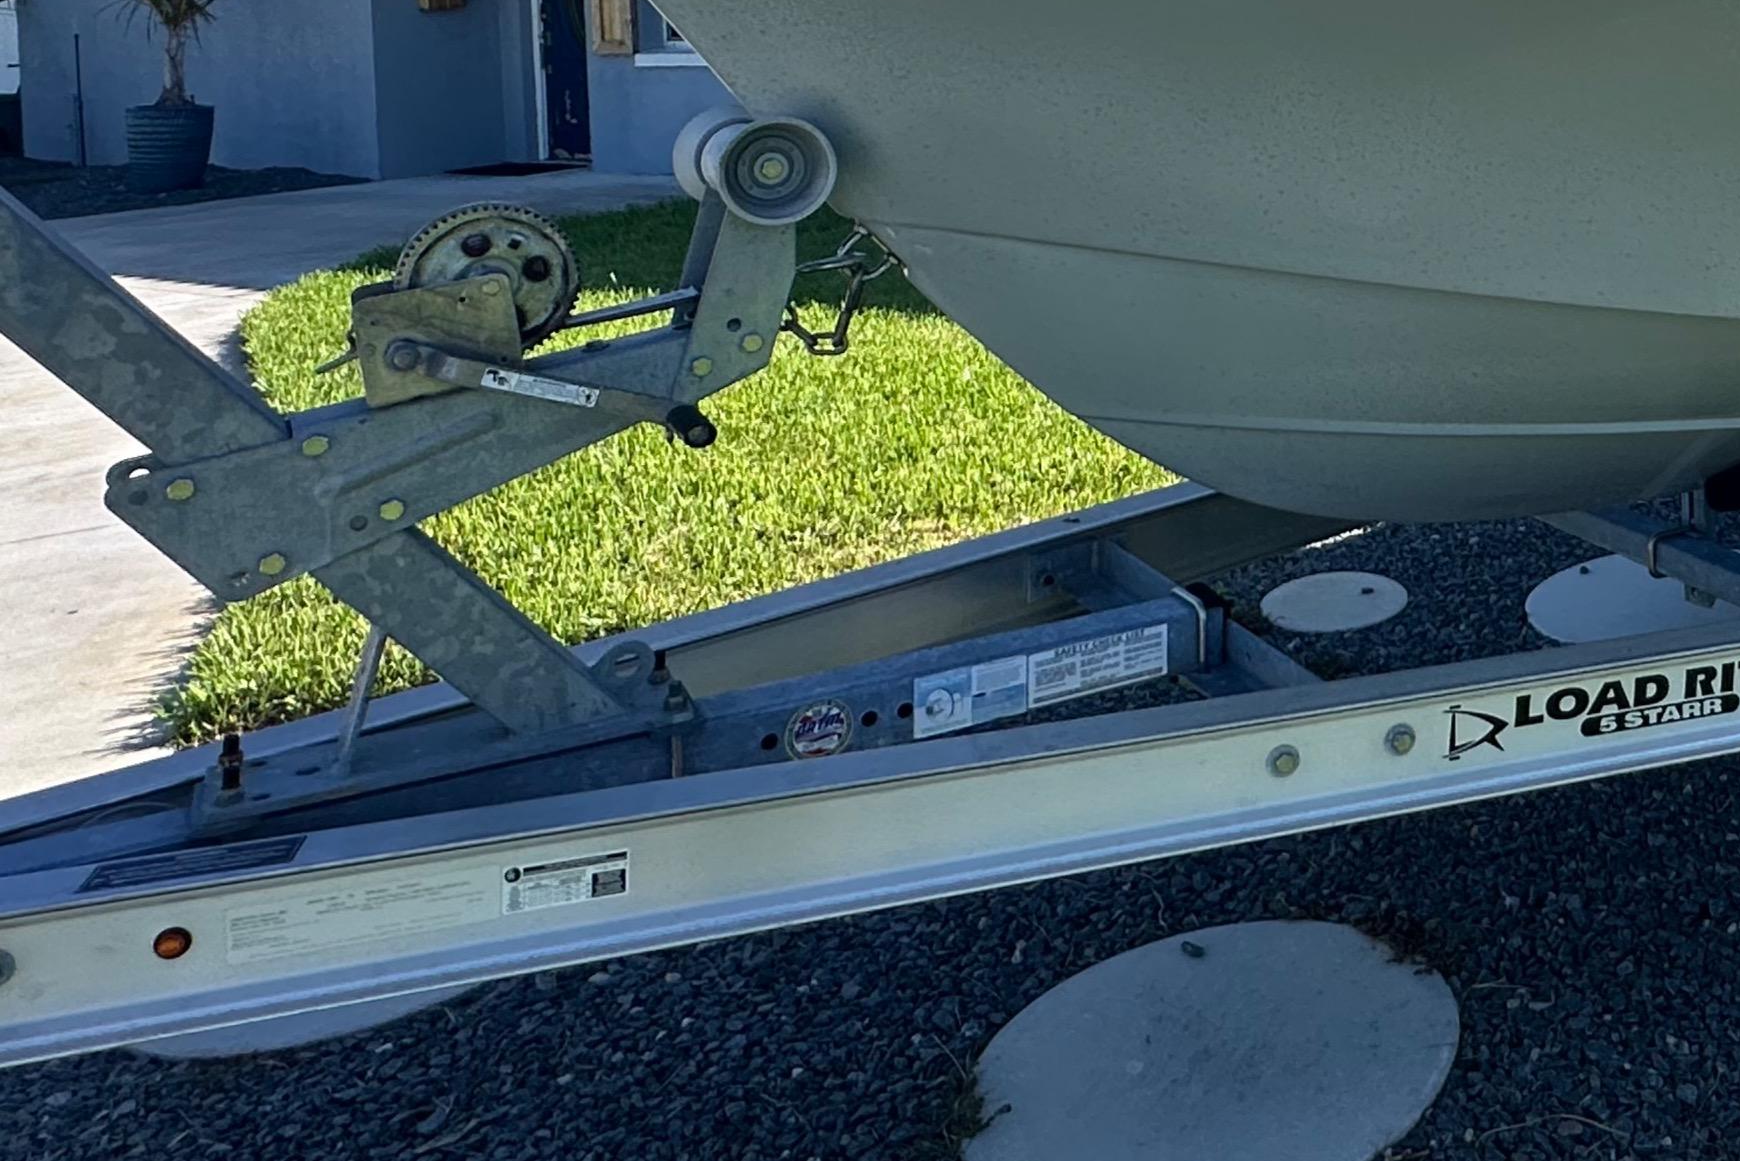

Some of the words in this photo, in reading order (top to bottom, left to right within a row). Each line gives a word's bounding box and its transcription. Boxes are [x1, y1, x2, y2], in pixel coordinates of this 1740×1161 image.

[1513, 674, 1670, 728] LOAD
[1599, 715, 1618, 733] 5
[1623, 699, 1723, 729] STARR
